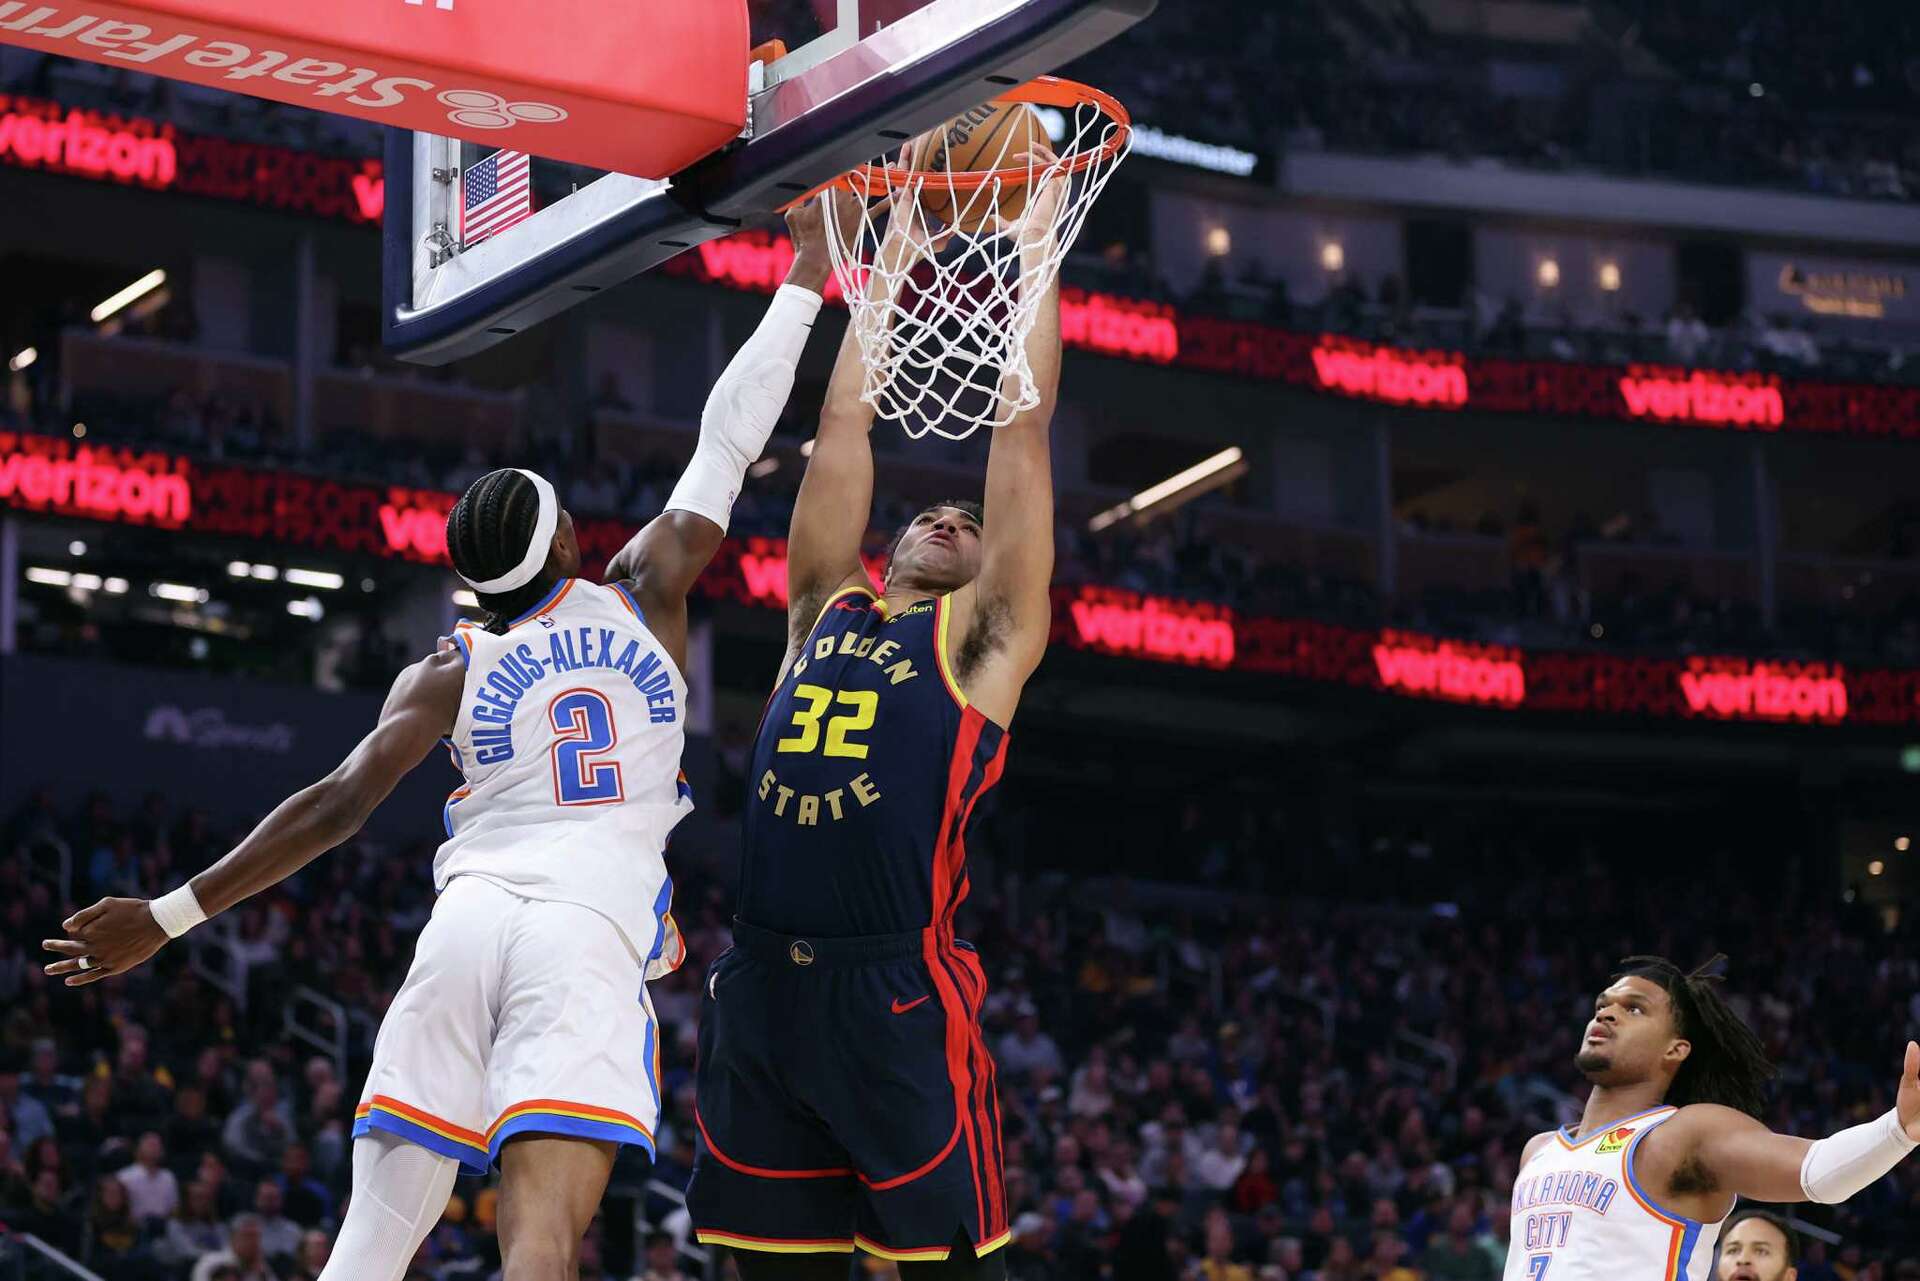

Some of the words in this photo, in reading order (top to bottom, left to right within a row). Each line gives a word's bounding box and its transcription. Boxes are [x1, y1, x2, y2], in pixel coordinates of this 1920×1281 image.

[1060, 295, 1178, 359] rizon
[1312, 347, 1468, 405] verizon
[1620, 371, 1784, 429] verizon
[1071, 598, 1235, 663] verizon
[471, 627, 676, 765] GILGEOUS-ALEXANDER
[1373, 644, 1526, 704] verizon
[1680, 668, 1848, 720] verizon
[549, 687, 625, 806] 2
[777, 684, 879, 759] 32
[758, 768, 881, 826] STATE
[1512, 1171, 1618, 1216] KLAHOMA
[1525, 1212, 1572, 1250] CITY
